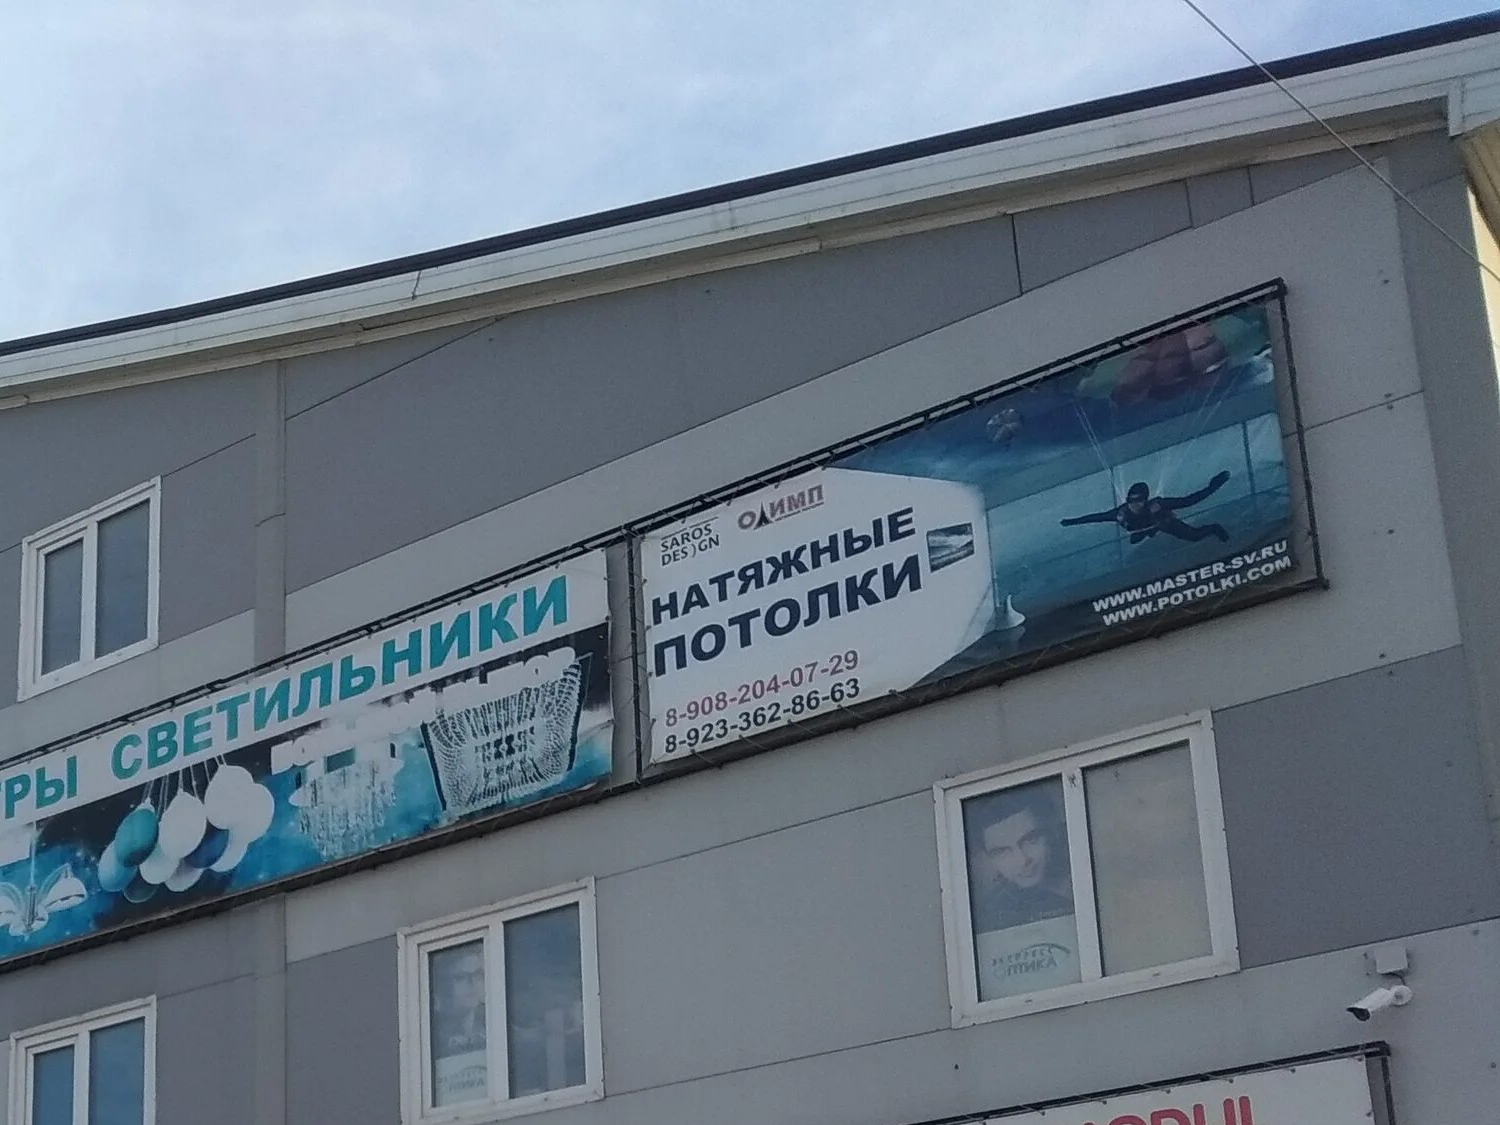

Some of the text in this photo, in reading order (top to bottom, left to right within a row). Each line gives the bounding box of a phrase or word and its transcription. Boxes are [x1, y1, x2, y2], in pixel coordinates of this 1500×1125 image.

[661, 523, 712, 553] SAROS
[738, 484, 824, 531] ОЛИМП
[652, 507, 916, 625] НАТЯЖНЫЕ
[1092, 540, 1288, 612] WWW.MASTER-SV.RU
[1102, 556, 1291, 626] WWW.POTOLKI.COM
[653, 553, 922, 677] ПОТОЛКИ
[110, 576, 568, 781] СВЕТИЛЬНИКИ
[665, 650, 859, 727] 8-908-204-07-29
[665, 677, 860, 754] 8-923-362-86-63
